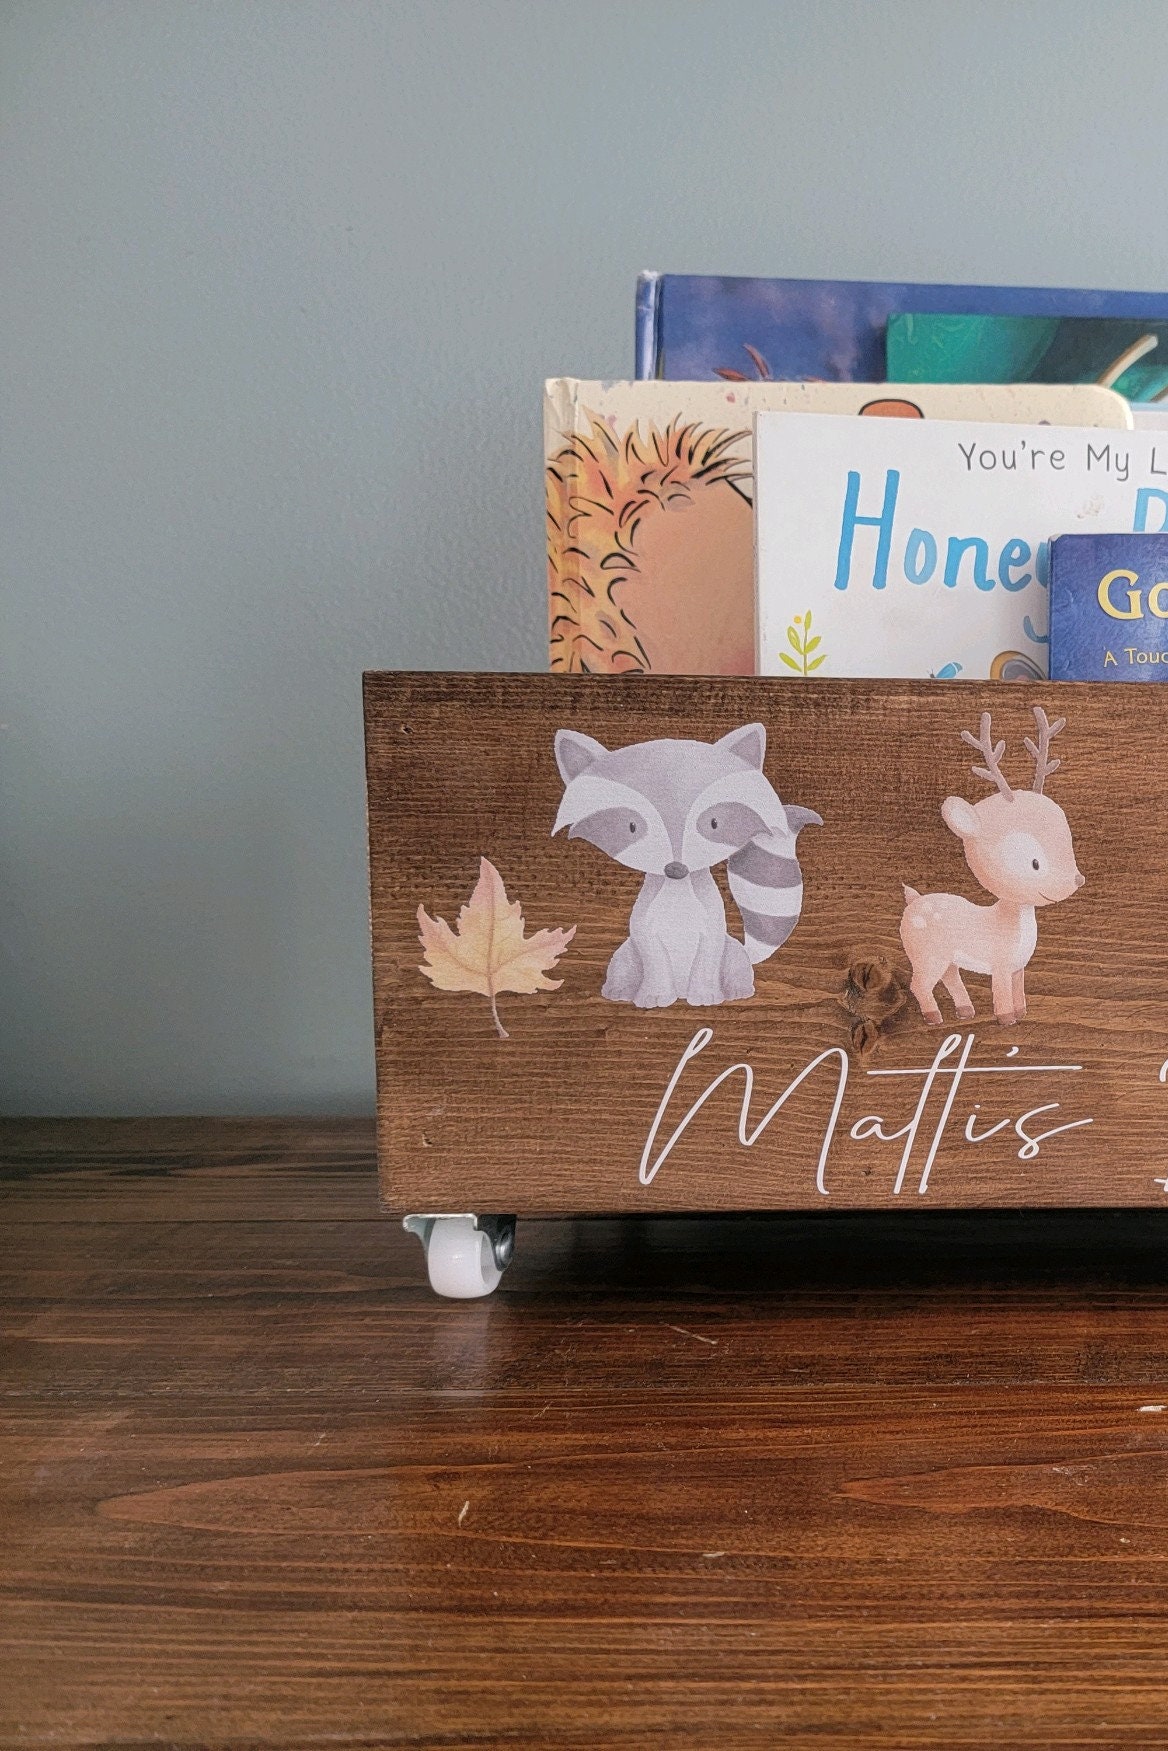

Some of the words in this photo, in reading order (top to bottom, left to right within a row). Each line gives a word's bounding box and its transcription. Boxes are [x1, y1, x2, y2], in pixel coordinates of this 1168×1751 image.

[957, 440, 1066, 471] You're
[1086, 443, 1130, 482] My
[1103, 650, 1119, 668] A
